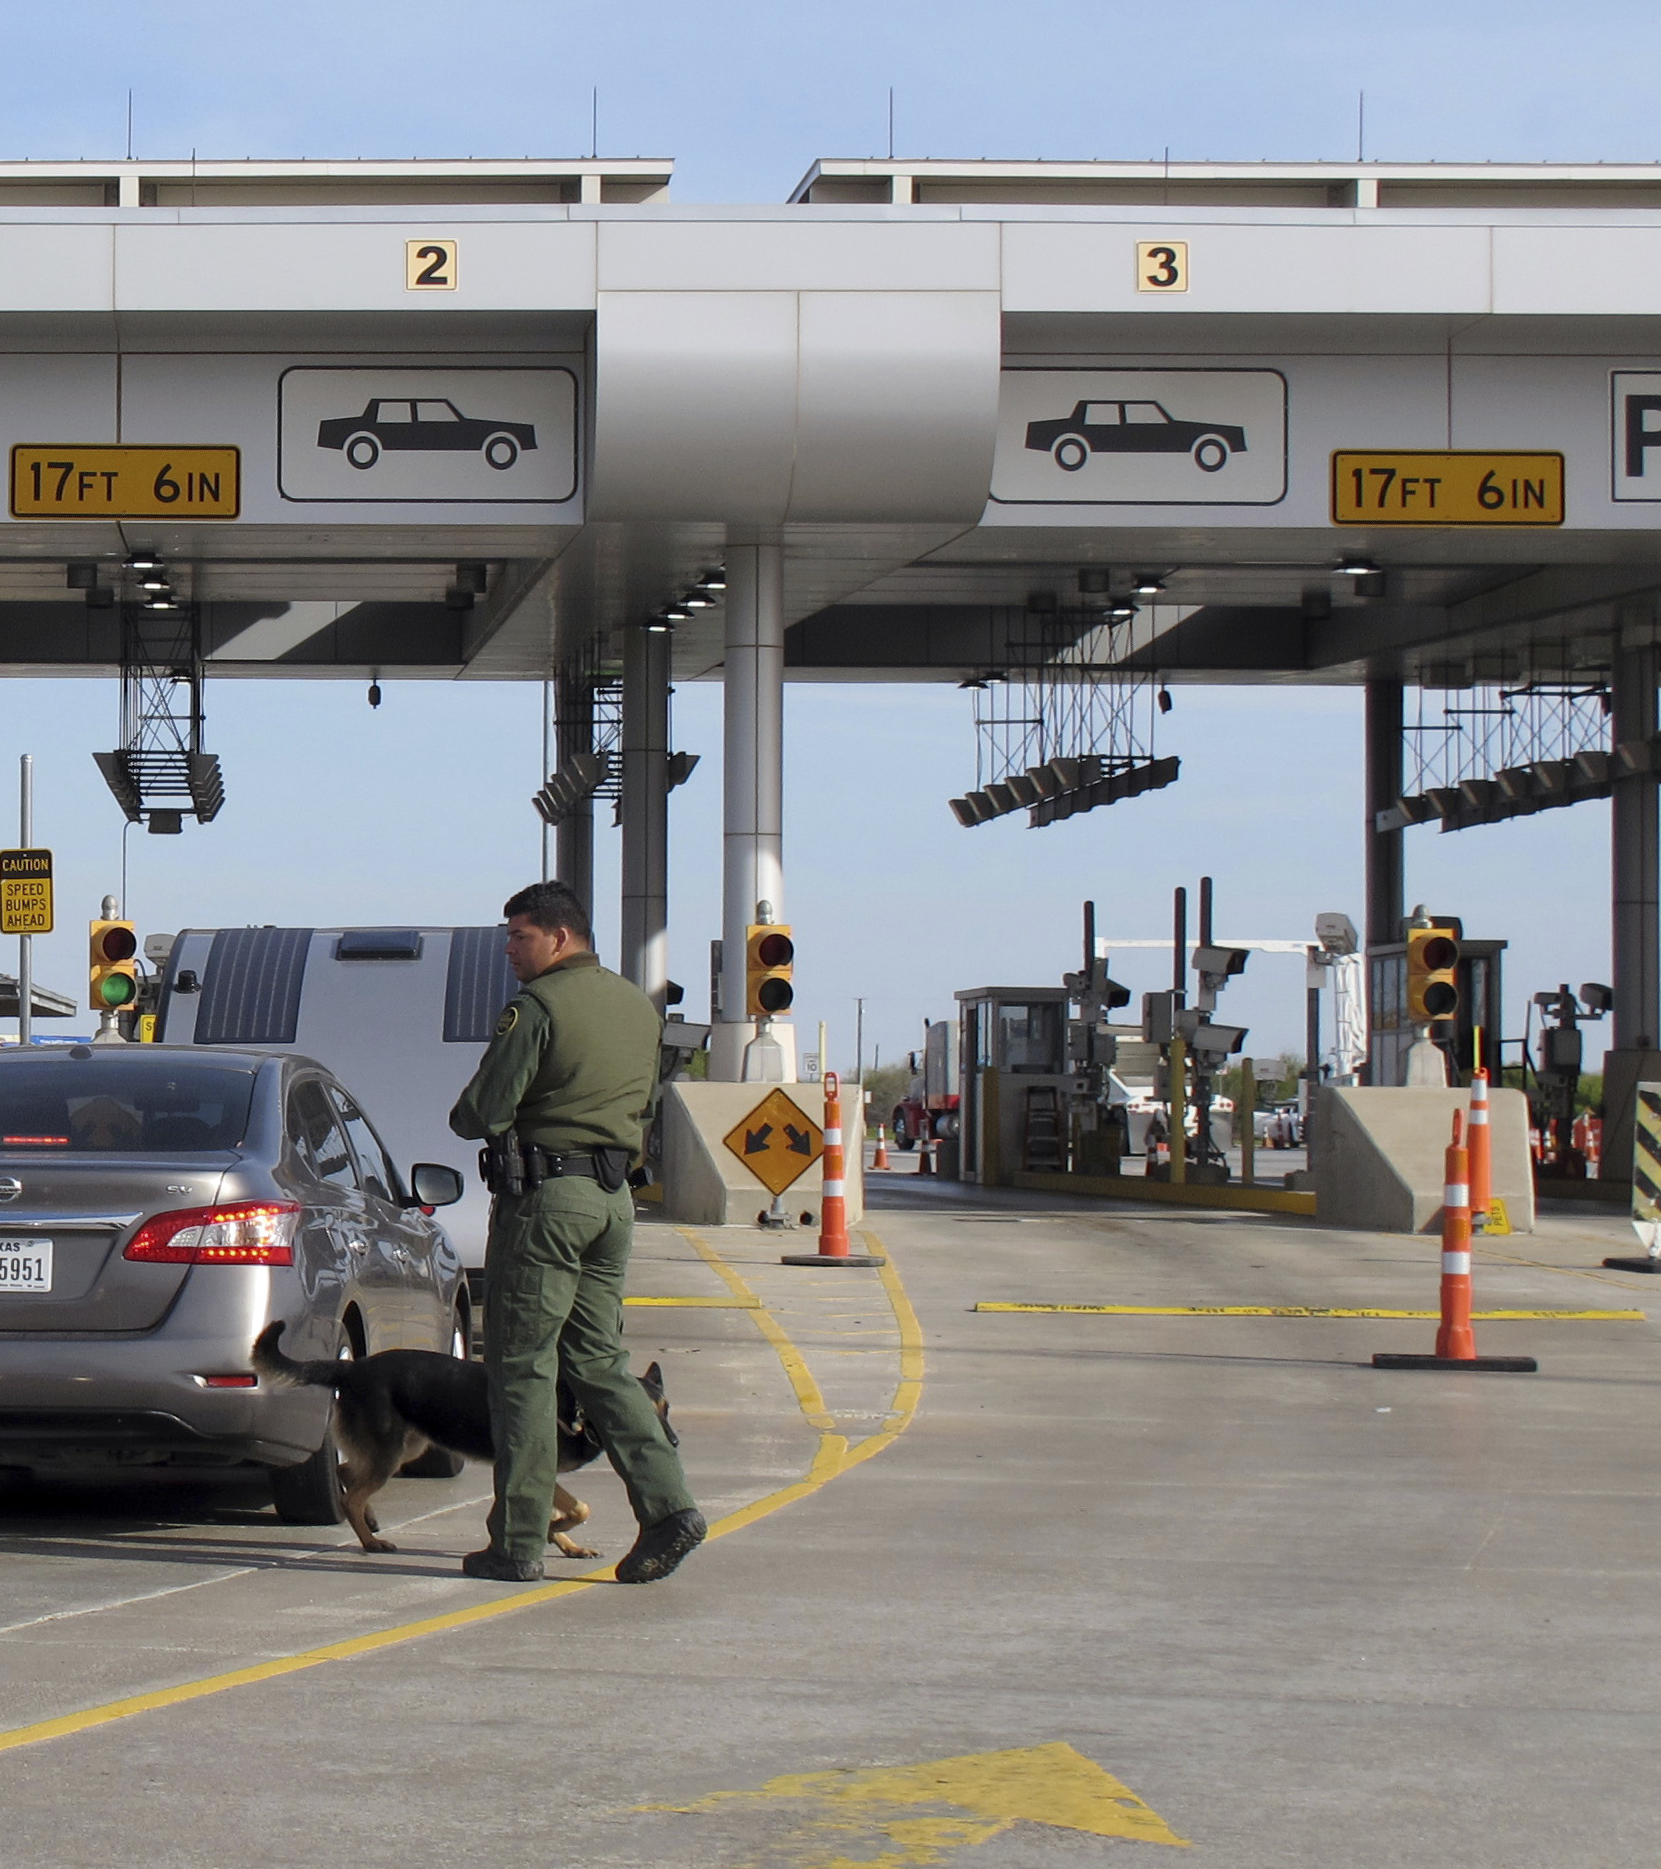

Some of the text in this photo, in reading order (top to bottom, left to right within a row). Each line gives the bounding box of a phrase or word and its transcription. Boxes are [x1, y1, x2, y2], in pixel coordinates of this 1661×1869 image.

[415, 246, 448, 285] 2
[1146, 247, 1178, 287] 3
[30, 461, 220, 503] 17FT 6IN
[1351, 468, 1545, 510] 17FT 6IN
[2, 859, 49, 871] CAUTION
[6, 883, 44, 896] SPEED
[5, 898, 47, 911] BUMPS
[7, 913, 45, 926] AHEAD
